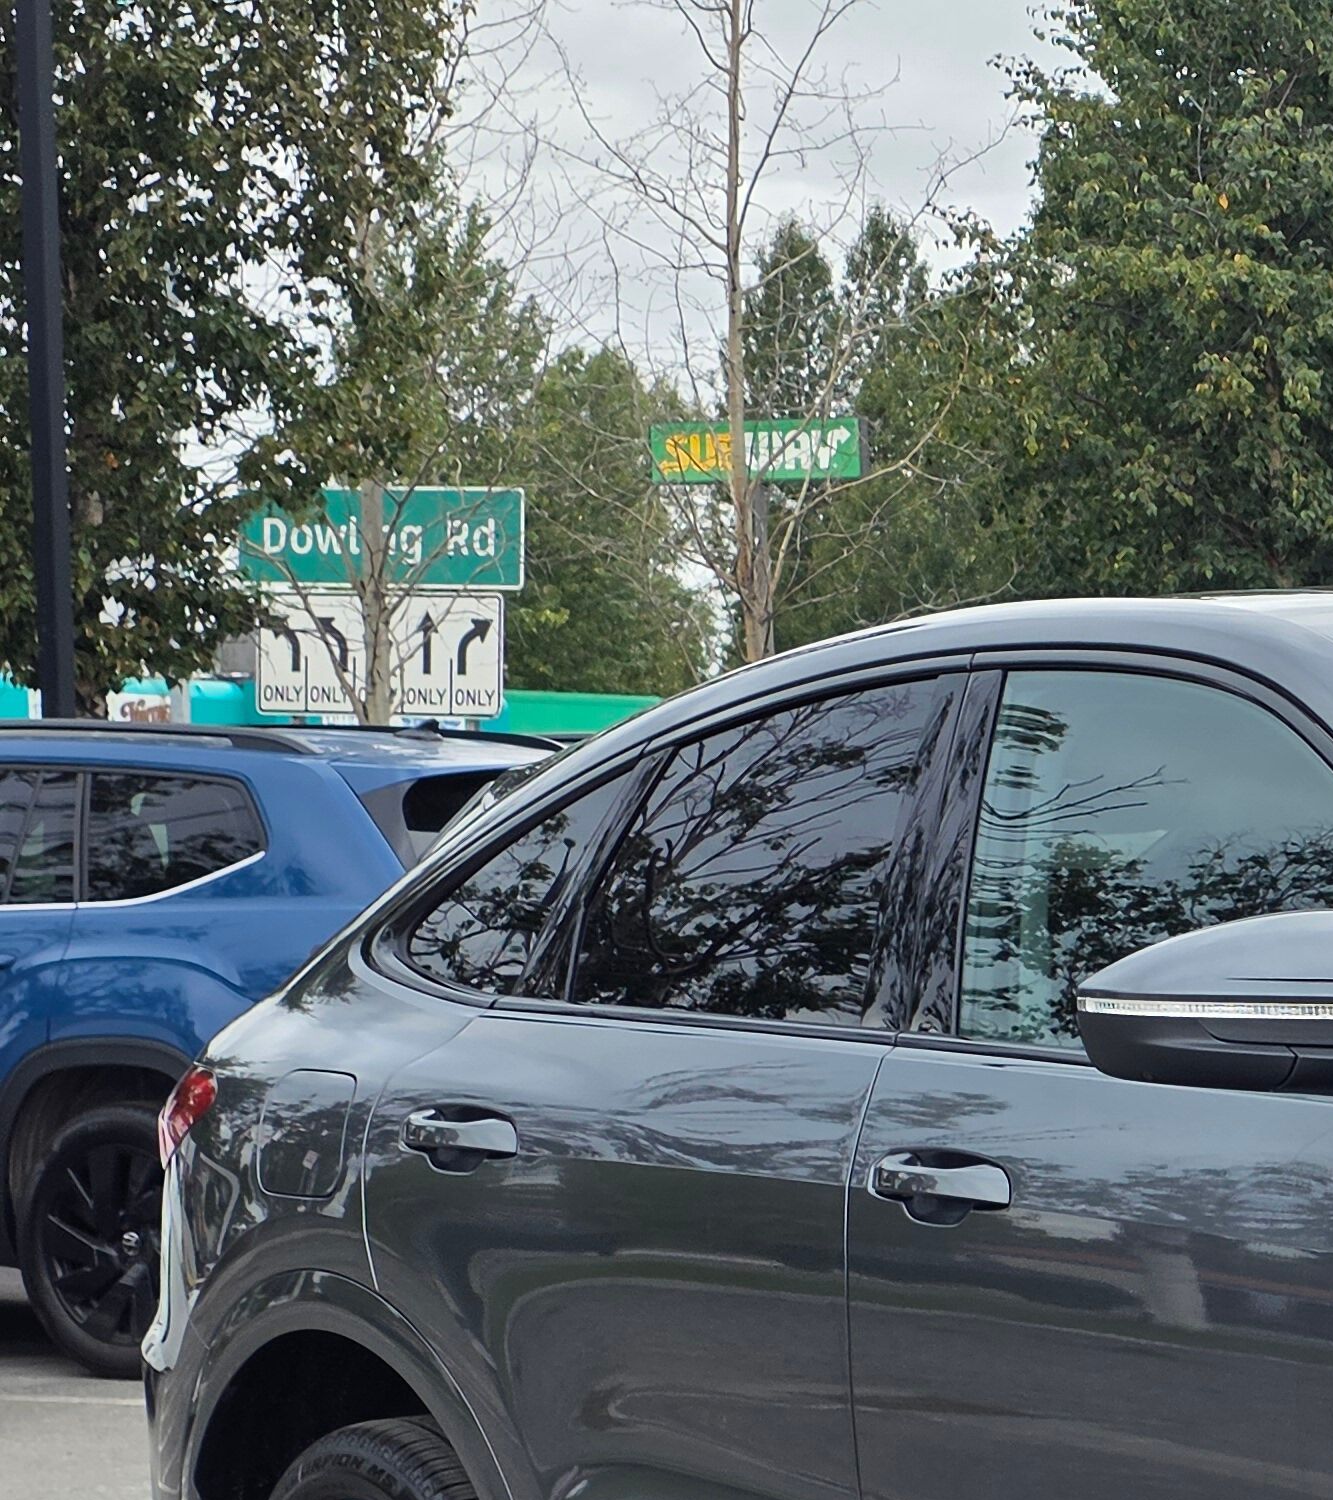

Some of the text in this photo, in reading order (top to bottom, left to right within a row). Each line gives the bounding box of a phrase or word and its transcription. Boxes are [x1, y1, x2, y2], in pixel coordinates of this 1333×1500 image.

[446, 512, 495, 557] Rd
[263, 684, 303, 703] ONLY
[406, 687, 447, 706] ONLY
[454, 688, 496, 707] ONLY
